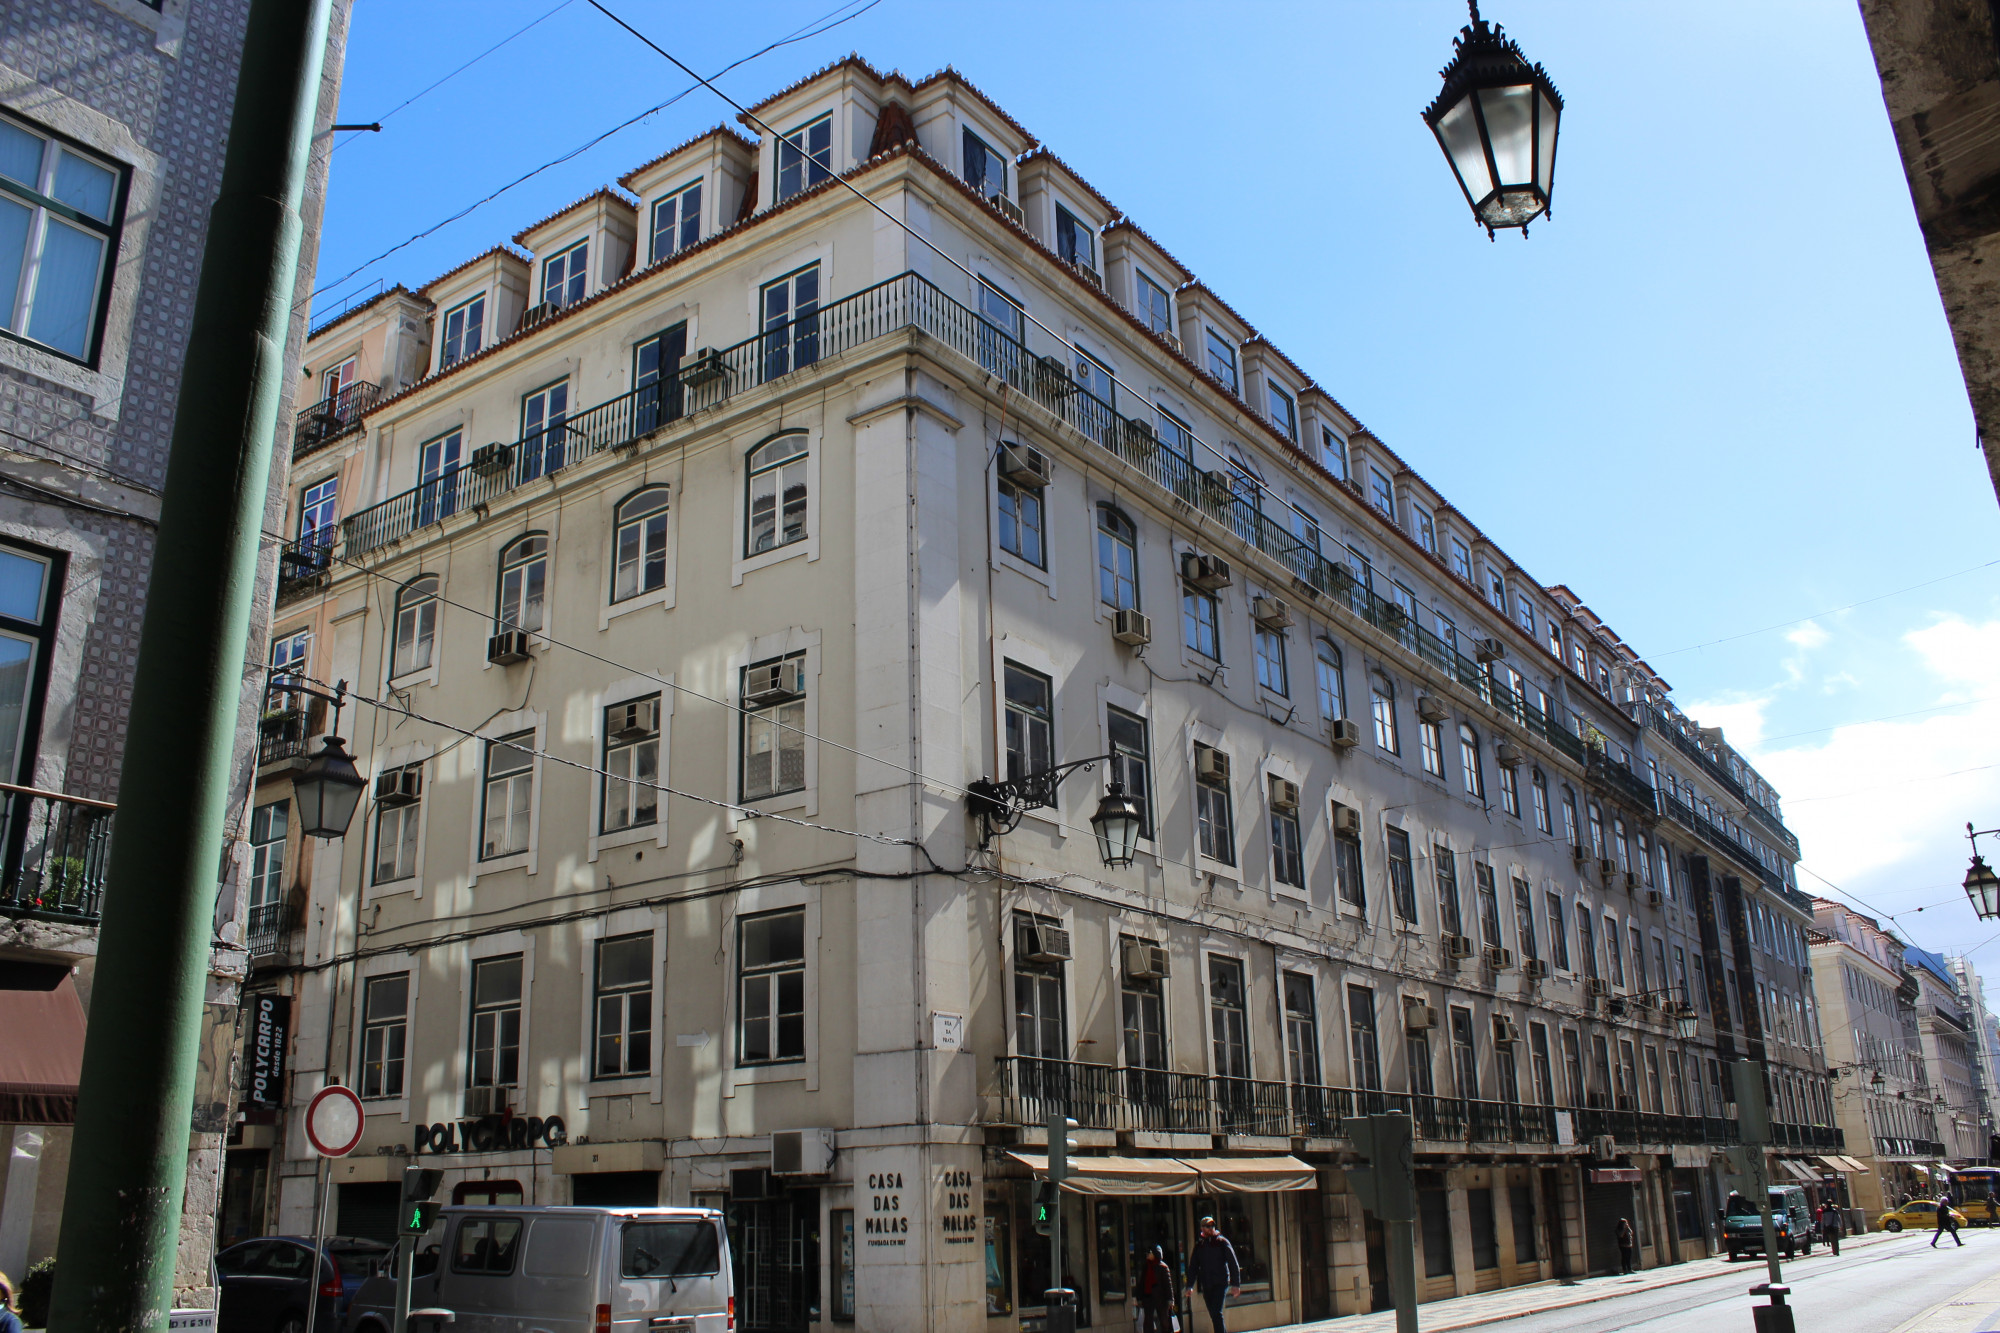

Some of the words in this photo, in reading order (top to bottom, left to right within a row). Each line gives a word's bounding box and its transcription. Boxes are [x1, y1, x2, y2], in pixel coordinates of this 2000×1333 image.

[275, 1026, 283, 1048] 1822
[253, 999, 274, 1103] POLYCARPO
[272, 1051, 281, 1078] desde
[414, 1116, 567, 1154] POLYCARPO
[869, 1173, 903, 1189] CASA
[945, 1171, 972, 1188] CASA
[874, 1195, 899, 1211] DAS
[949, 1192, 969, 1209] DAS
[865, 1217, 908, 1234] MALAS
[943, 1215, 976, 1232] MALAS
